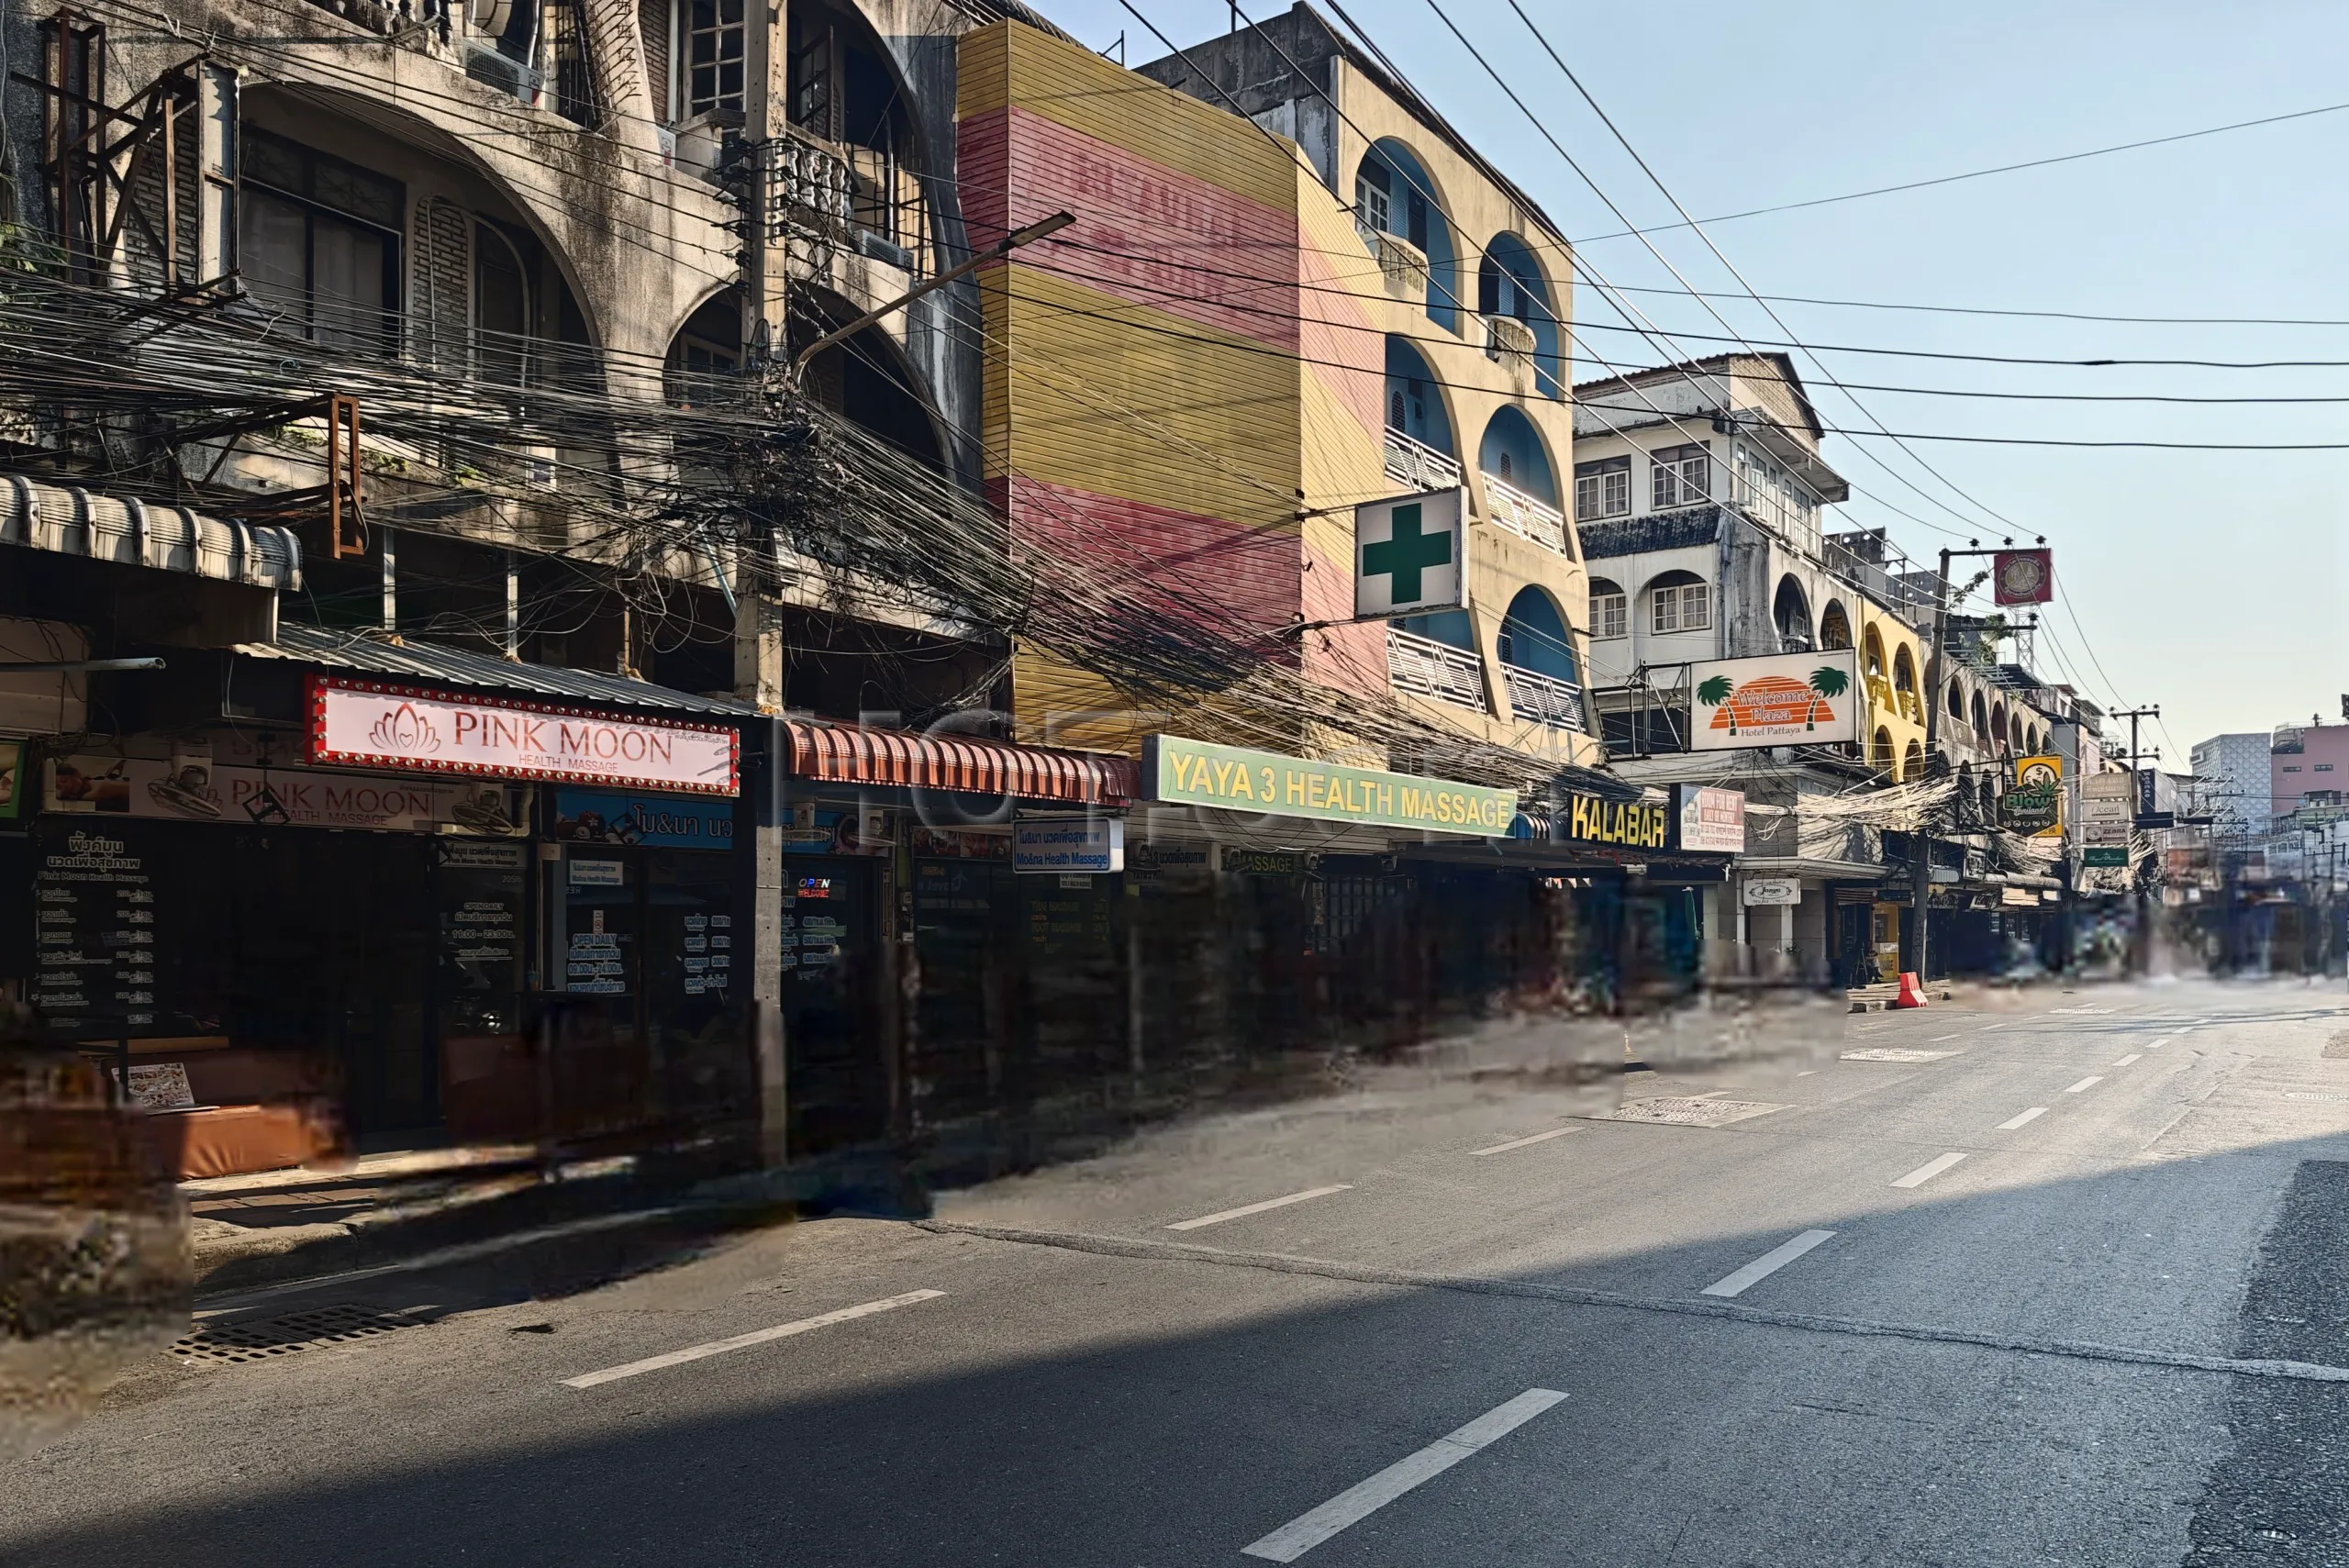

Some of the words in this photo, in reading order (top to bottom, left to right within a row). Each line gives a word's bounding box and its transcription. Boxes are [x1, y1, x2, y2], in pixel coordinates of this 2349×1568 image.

[1737, 688, 1809, 706] Welcome
[1751, 707, 1791, 722] Plaza
[453, 710, 546, 753] PINK
[560, 723, 672, 766] MOON
[1741, 726, 1765, 737] Hotel
[1767, 726, 1800, 737] Pattaya
[518, 753, 561, 768] HEALTH
[569, 759, 618, 773] MASSAGE
[1170, 751, 1254, 800] YAYA
[1259, 766, 1276, 803] 3
[1286, 770, 1394, 815] HEALTH
[1401, 785, 1510, 829] MASSAGE
[231, 779, 315, 809] PINK
[325, 786, 430, 817] MOON
[2005, 793, 2051, 808] Blow
[2013, 806, 2046, 816] Thailand
[2091, 805, 2120, 813] Ocean
[328, 812, 388, 826] MASSAGE
[1572, 795, 1664, 848] KALABAR
[1017, 852, 1042, 865] Mo&na
[1045, 852, 1070, 865] Health
[1072, 852, 1107, 867] Massage
[798, 878, 831, 888] OPEN
[573, 933, 594, 945] OPEN
[595, 934, 617, 945] DAILY
